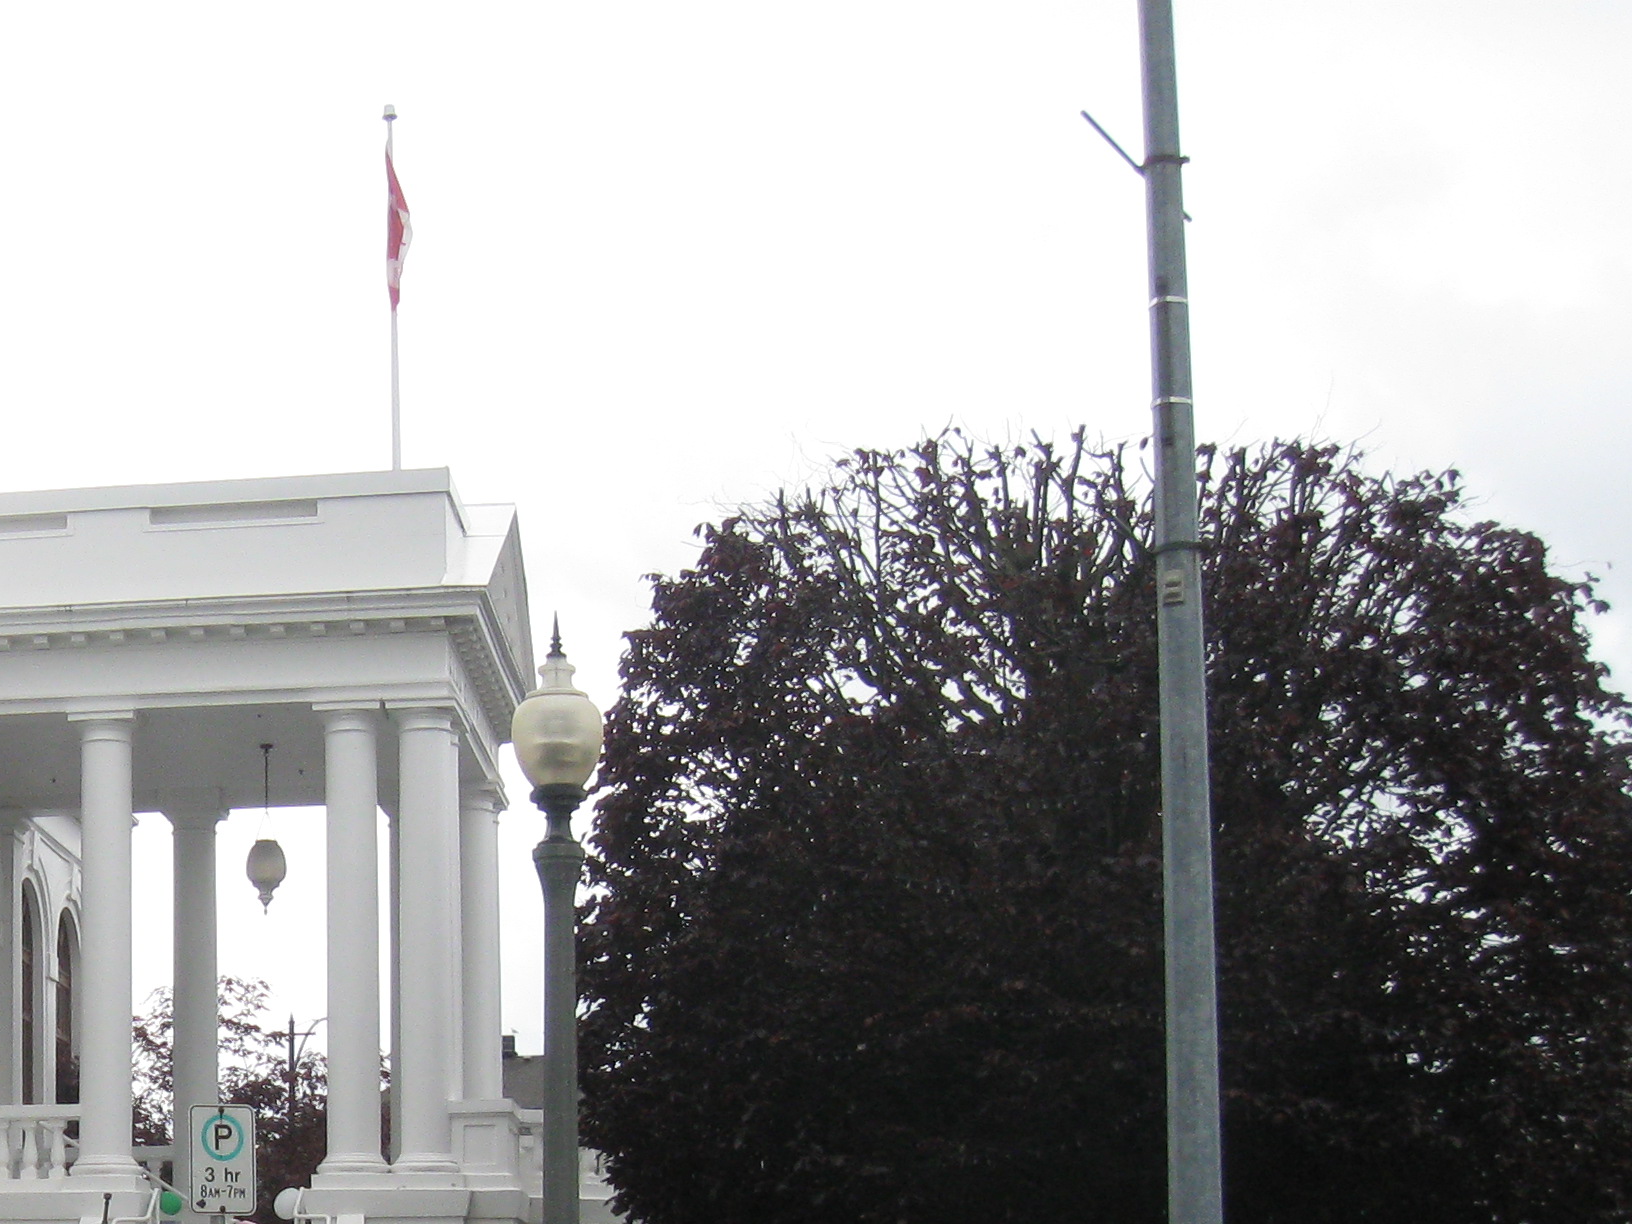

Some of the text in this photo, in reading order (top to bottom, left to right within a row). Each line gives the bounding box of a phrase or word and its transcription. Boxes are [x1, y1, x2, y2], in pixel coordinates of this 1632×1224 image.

[214, 1124, 232, 1150] P
[205, 1167, 241, 1182] 3 hr
[200, 1185, 246, 1199] 8AM-7PM
